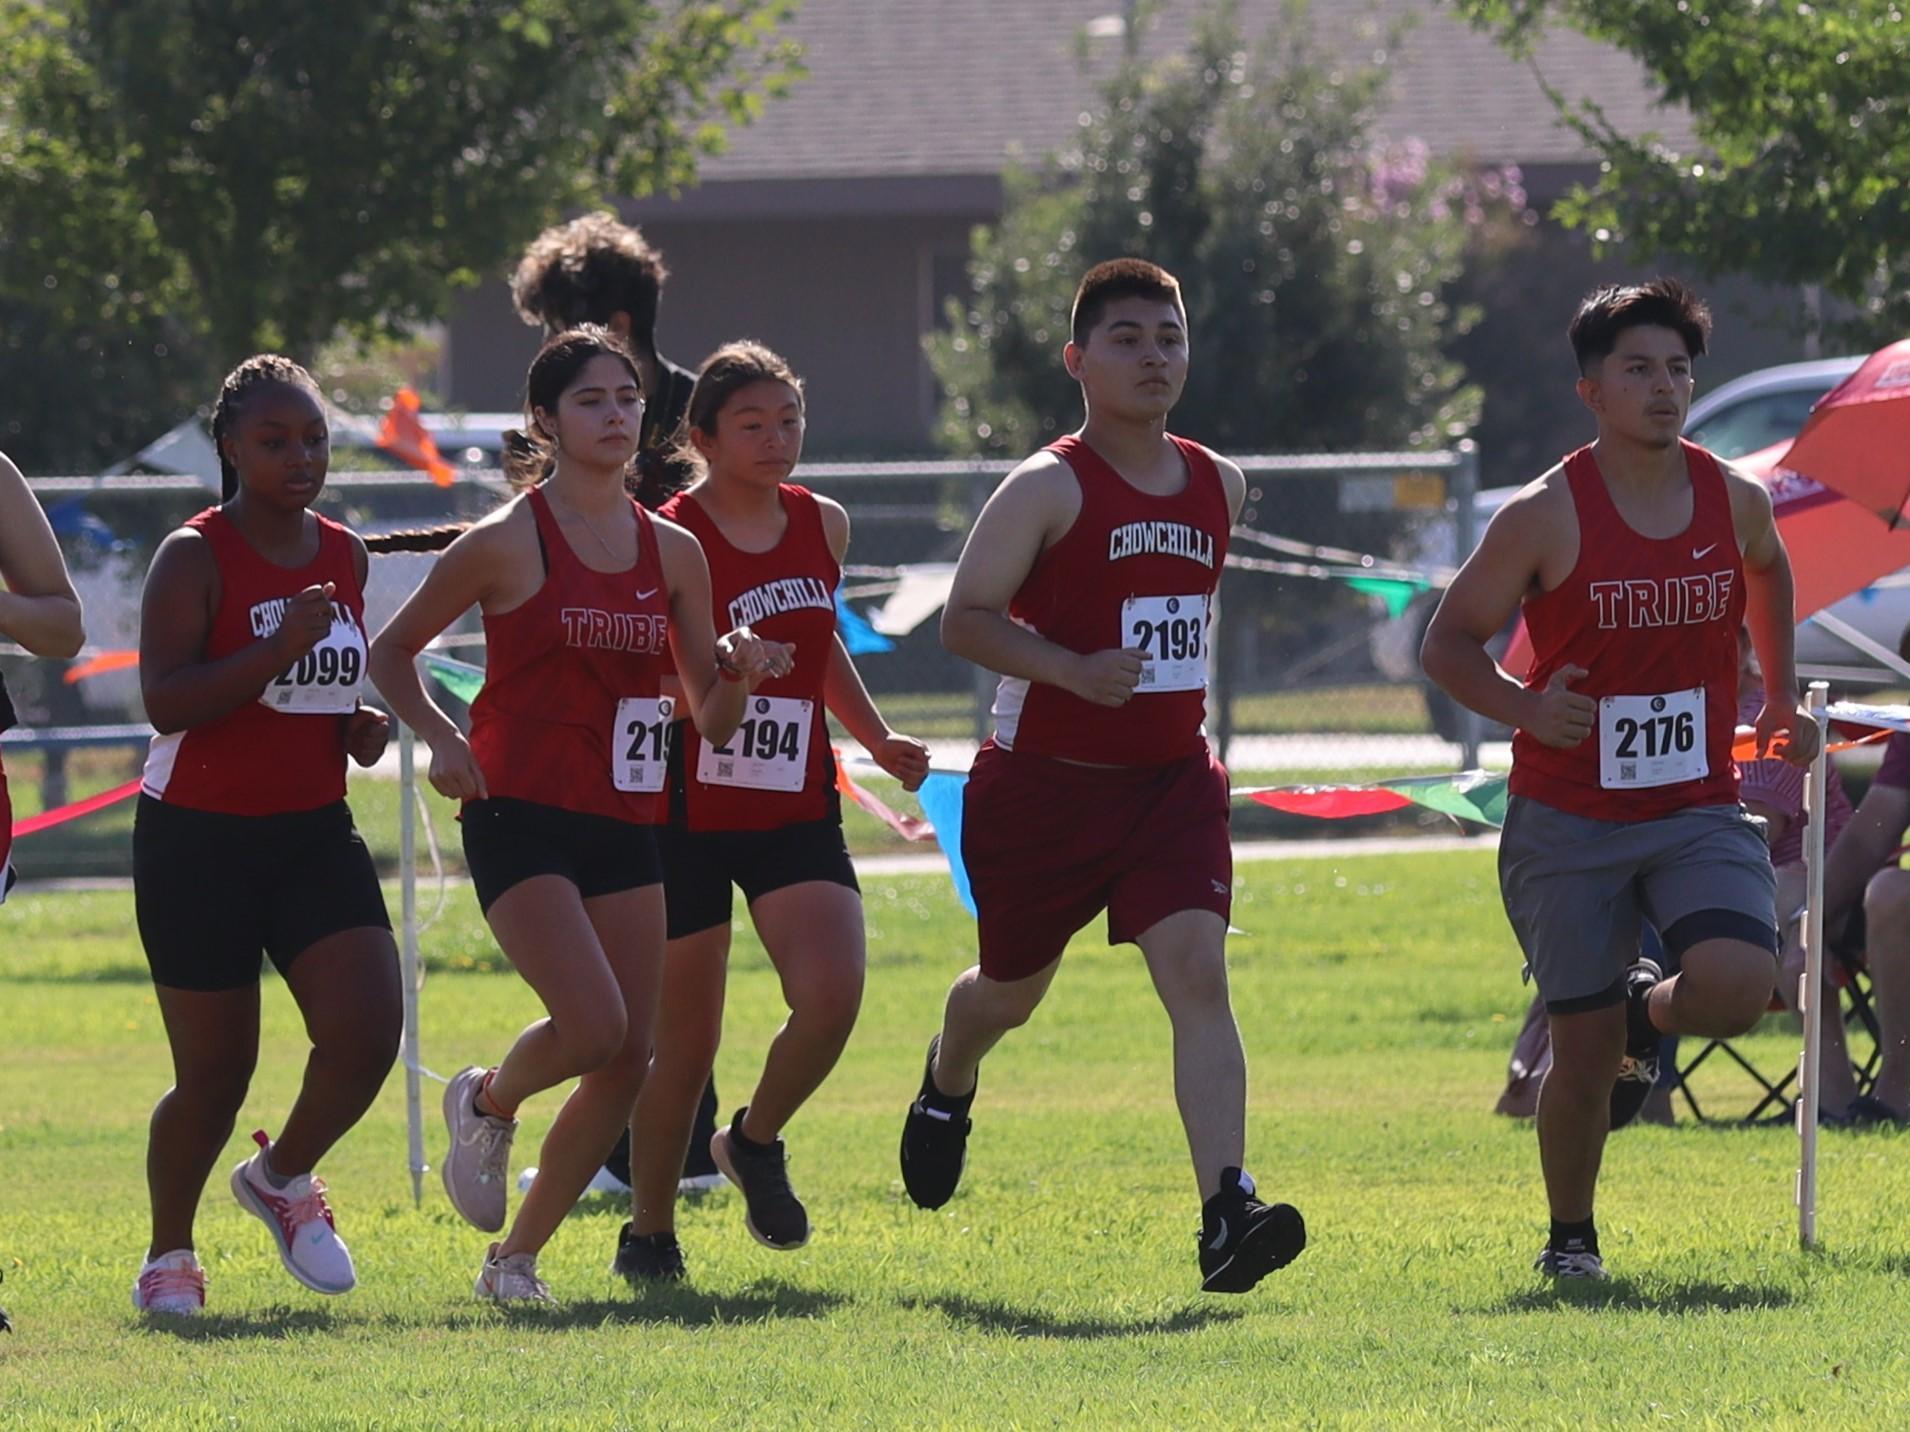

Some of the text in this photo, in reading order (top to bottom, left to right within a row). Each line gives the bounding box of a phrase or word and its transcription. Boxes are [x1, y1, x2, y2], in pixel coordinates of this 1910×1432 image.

[1109, 521, 1214, 569] CHOWCHILLA
[728, 577, 834, 630] CHOWCHILLA
[1590, 569, 1734, 628] TRIBE
[561, 607, 668, 655] TRIBE
[1133, 617, 1201, 661] 2193
[712, 718, 799, 761] 194
[1615, 711, 1694, 758] 2176
